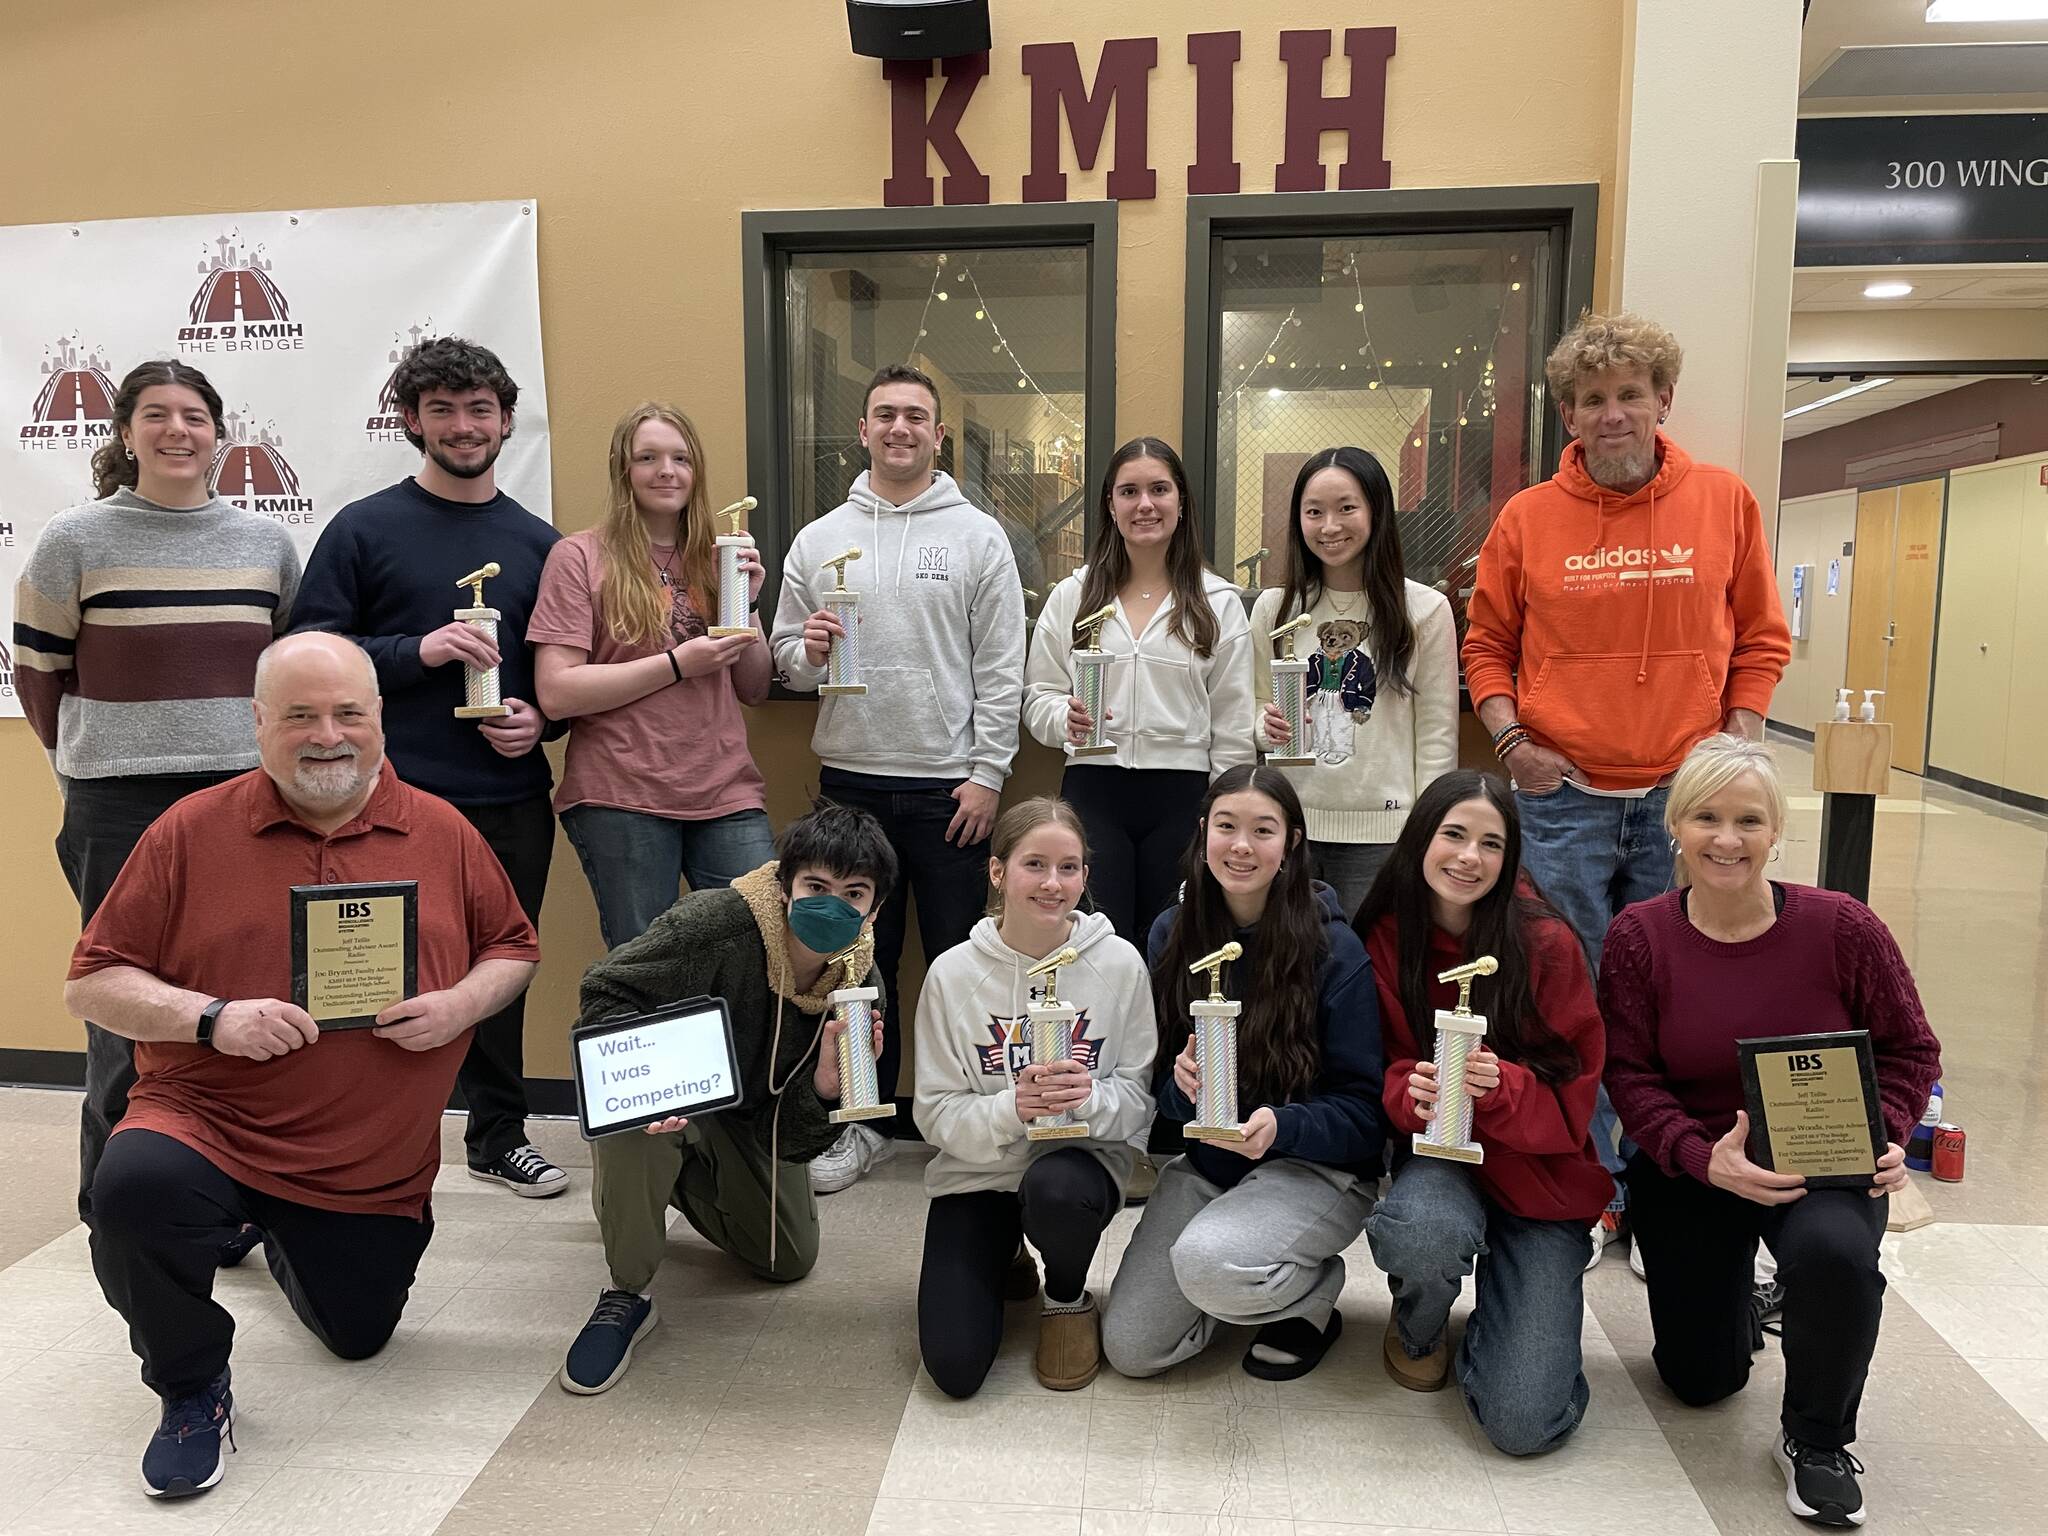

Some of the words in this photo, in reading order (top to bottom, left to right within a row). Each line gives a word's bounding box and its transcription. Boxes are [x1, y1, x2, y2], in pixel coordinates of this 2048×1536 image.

[883, 27, 1396, 207] KMIH
[1884, 160, 1946, 189] 300
[1957, 158, 2048, 187] WING
[178, 326, 237, 340] 88.9
[244, 323, 303, 338] KMIH
[177, 342, 217, 353] THE
[226, 339, 305, 352] BRIDGE
[20, 425, 78, 438] 88.9
[84, 423, 114, 437] KM
[366, 417, 405, 430] 88
[19, 440, 57, 450] THE
[366, 432, 406, 442] THE
[254, 498, 313, 512] KMIH
[1564, 545, 1658, 570] adidas
[338, 902, 371, 919] IBS
[598, 1035, 656, 1057] Wait...
[1788, 1054, 1823, 1071] IBS
[601, 1070, 607, 1085] I
[611, 1064, 651, 1082] was
[605, 1073, 722, 1112] Competing?
